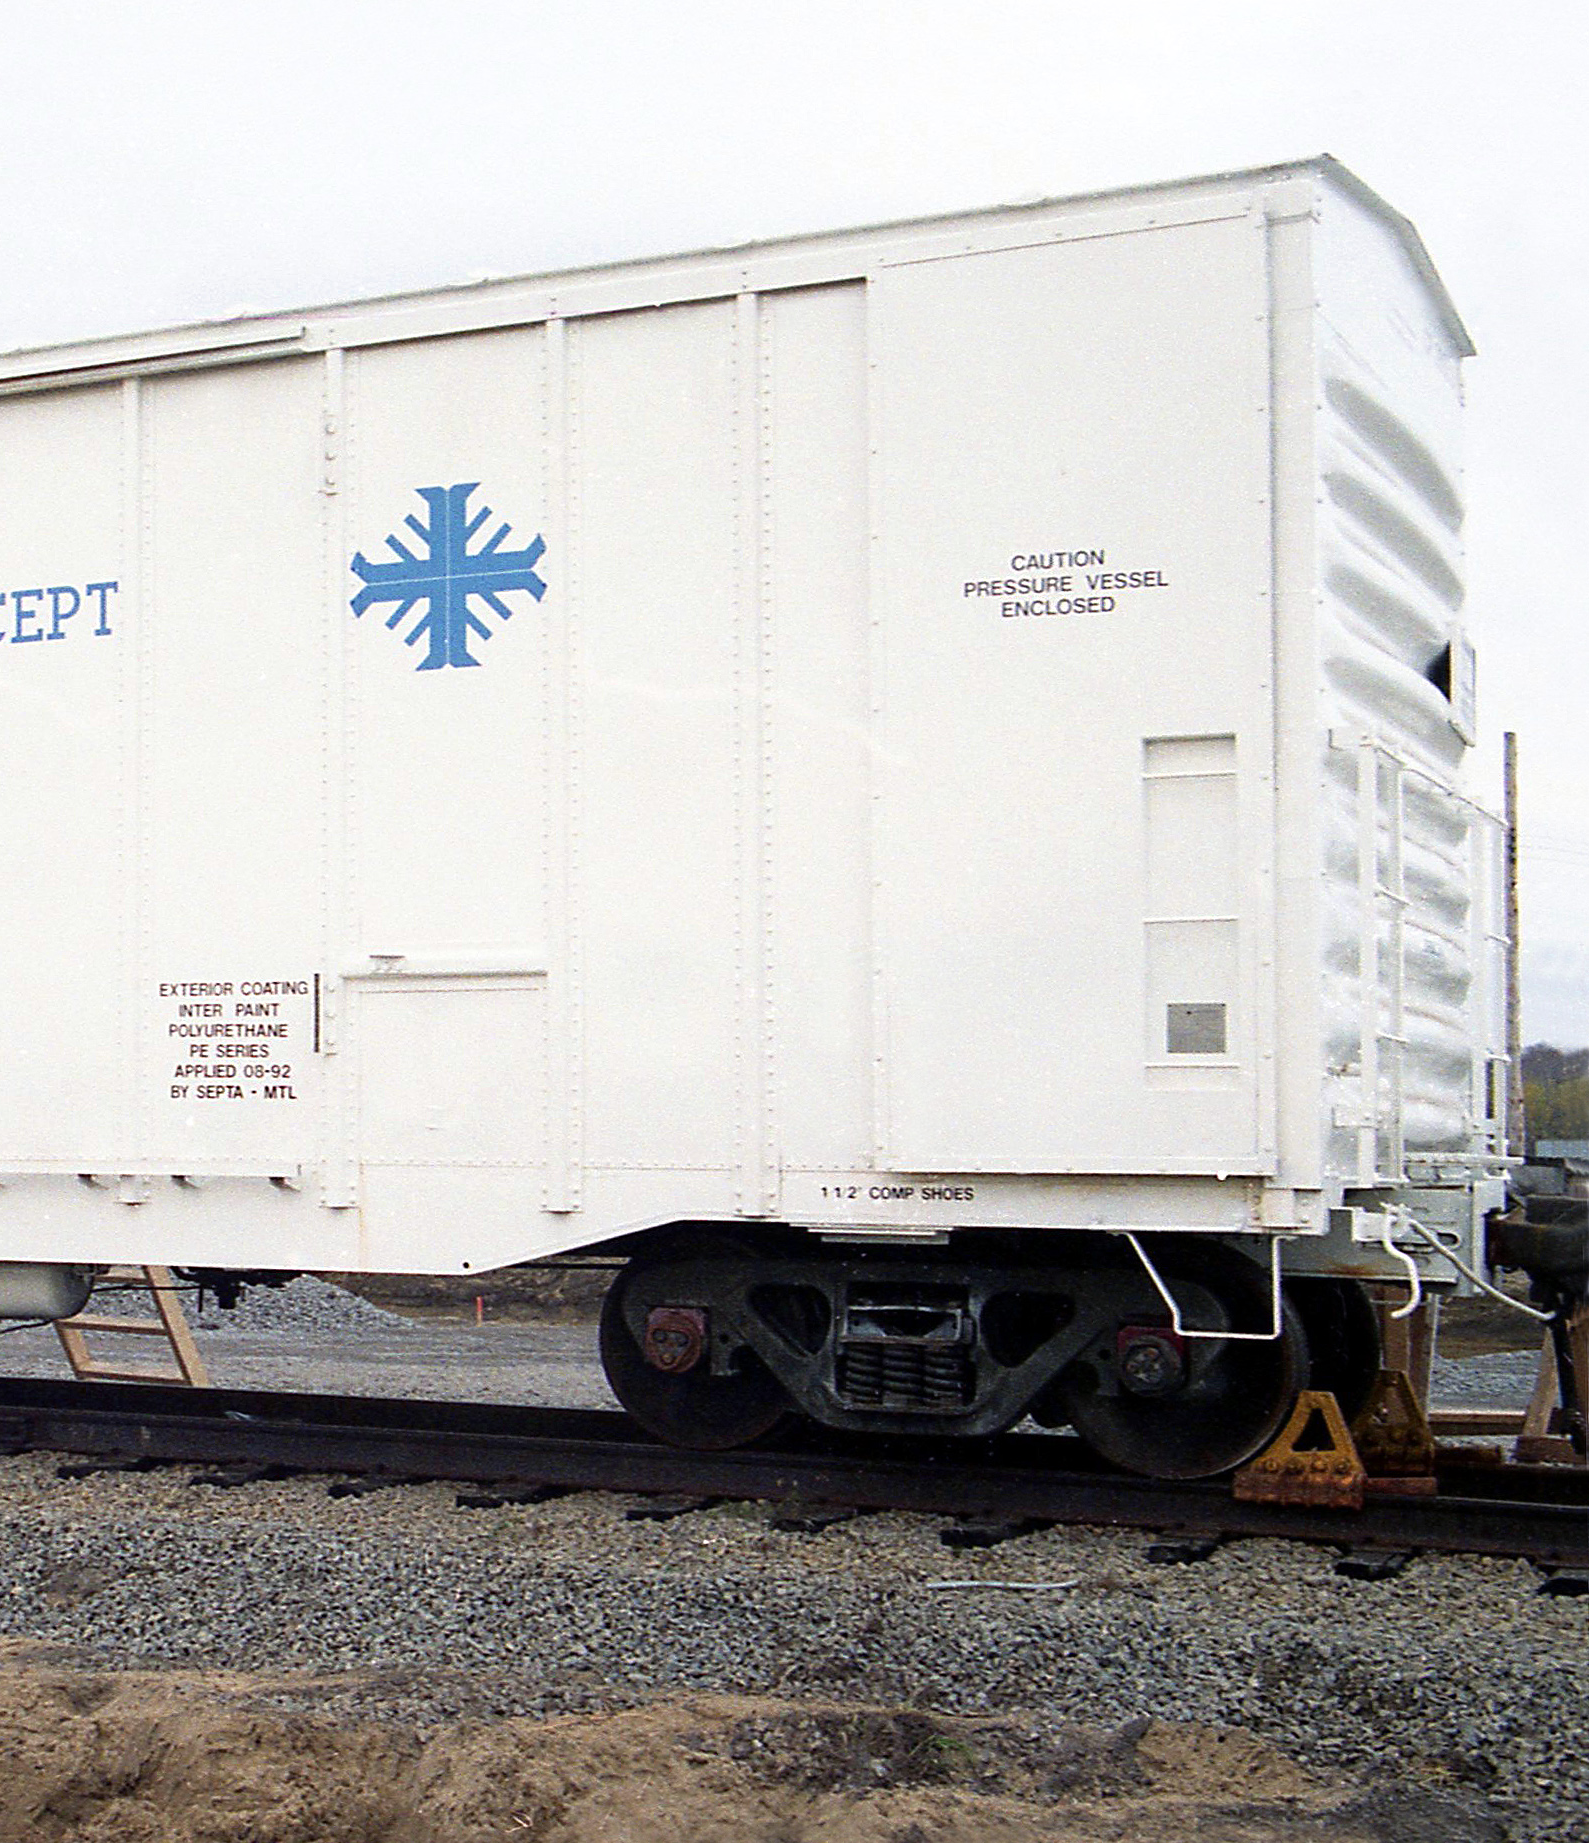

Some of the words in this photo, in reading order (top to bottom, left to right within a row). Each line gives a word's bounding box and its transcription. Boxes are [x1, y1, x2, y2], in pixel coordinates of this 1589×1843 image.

[1010, 549, 1106, 572] CAUTION
[963, 575, 1074, 598] PRESSURE
[1084, 570, 1170, 591] VESSEL
[1000, 596, 1116, 618] ENCLOSED
[159, 983, 234, 997] EXTERIOR
[240, 981, 309, 996] COATING
[178, 1003, 223, 1017] INTER
[235, 1003, 280, 1017] PAINT
[169, 1023, 289, 1038] POLYURETHANE
[190, 1044, 209, 1058] PE
[215, 1044, 270, 1058] SERIES
[174, 1064, 236, 1078] APPLIED
[243, 1064, 292, 1079] 08-92
[170, 1085, 189, 1099] BY
[196, 1085, 245, 1099] SEPTA
[263, 1085, 298, 1099] MTL
[868, 1186, 915, 1200] COMP
[921, 1187, 976, 1201] SHOES
